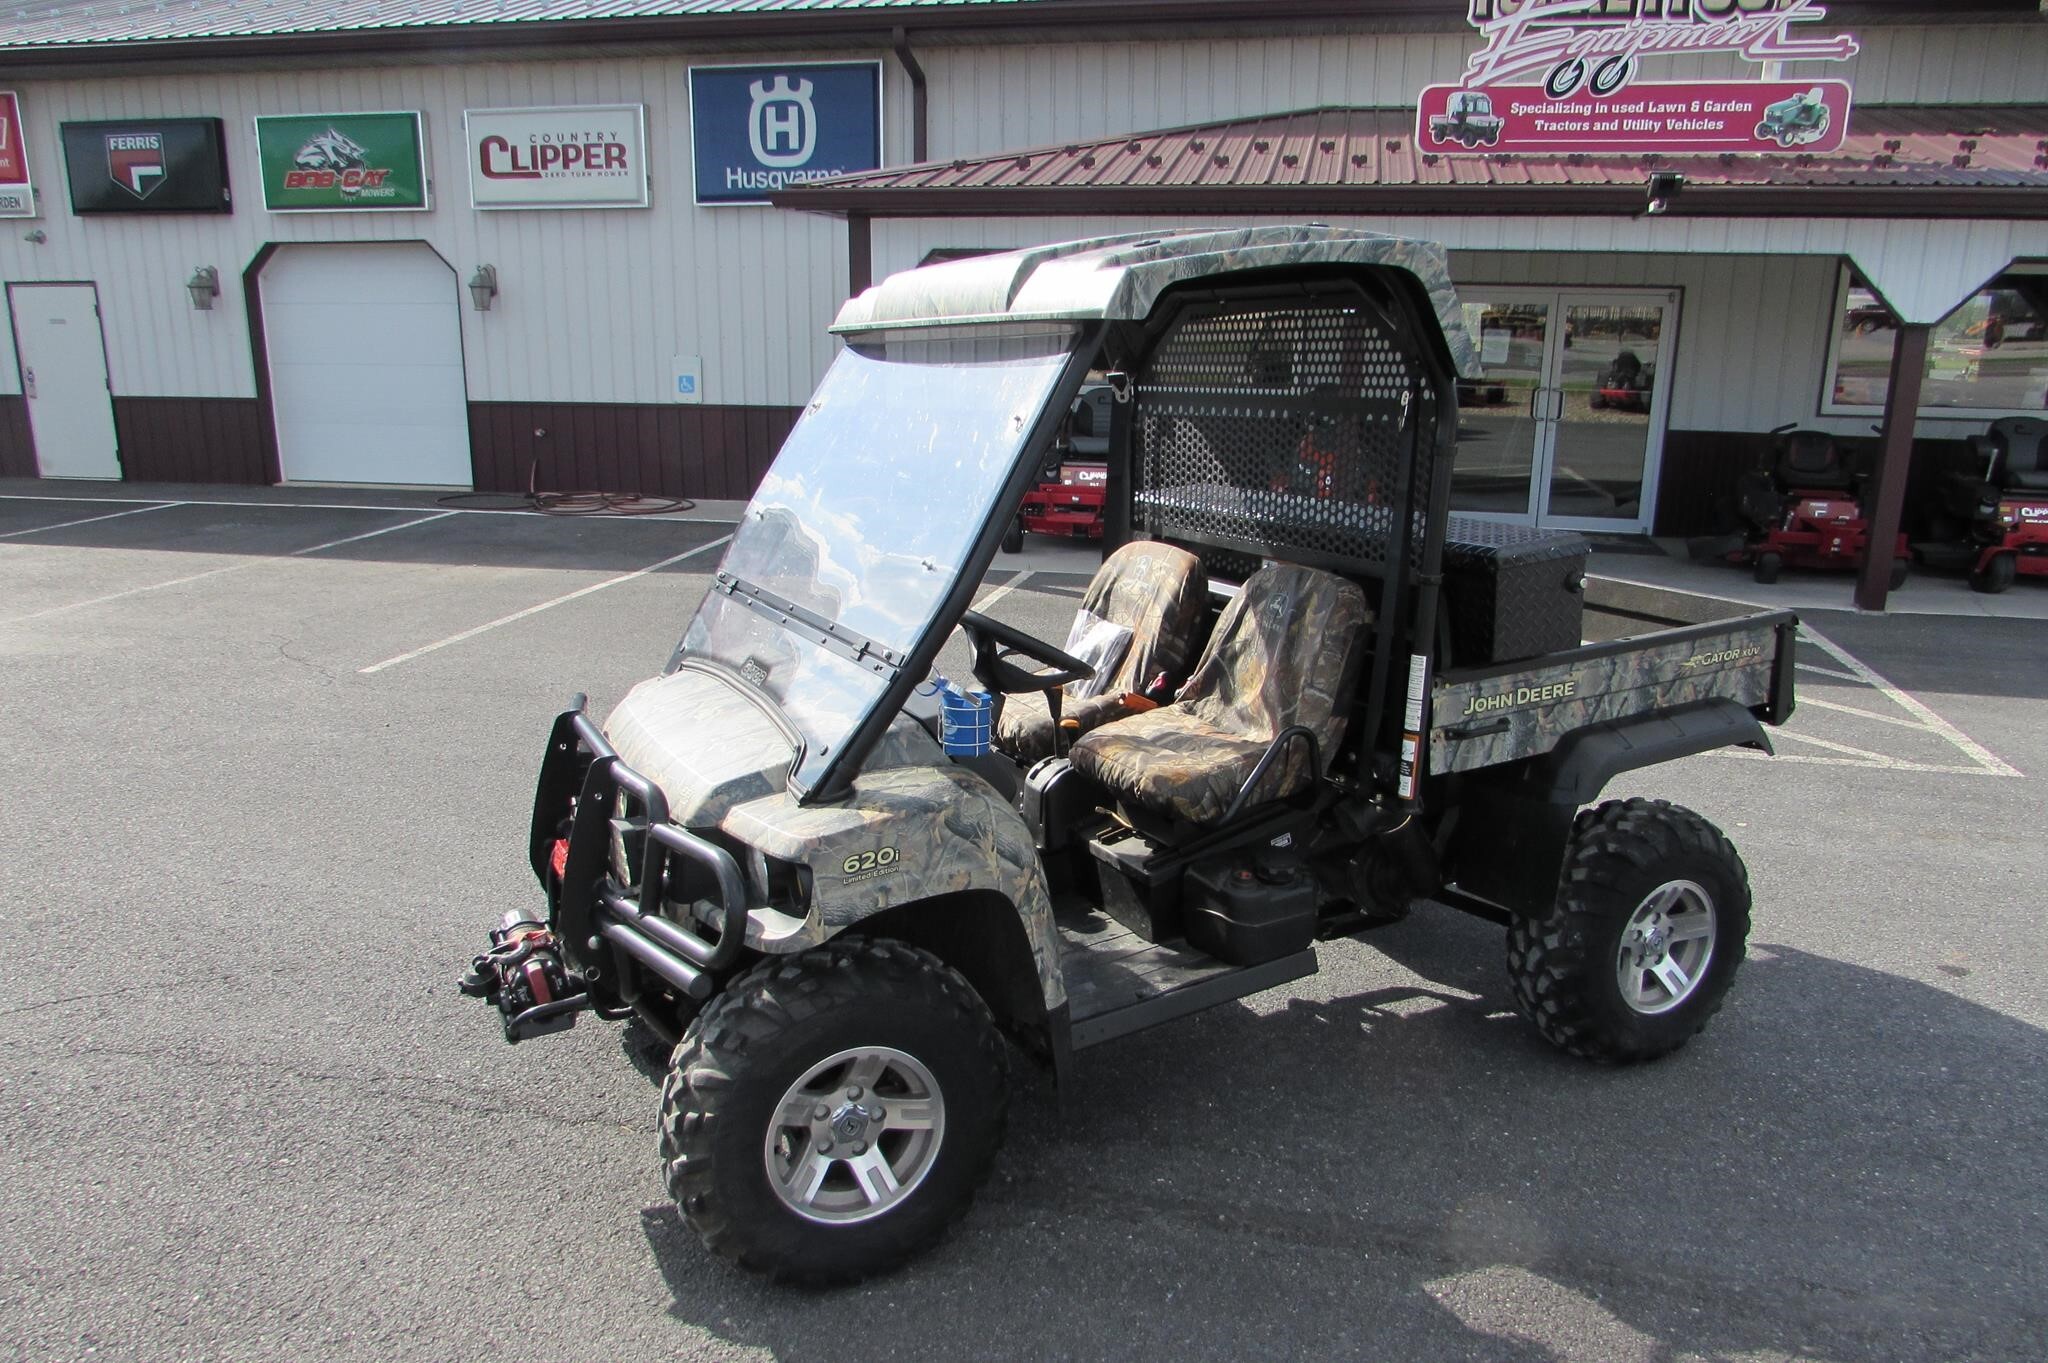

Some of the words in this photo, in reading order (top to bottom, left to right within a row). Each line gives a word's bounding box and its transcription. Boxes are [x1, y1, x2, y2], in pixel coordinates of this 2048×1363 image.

[1467, 0, 1846, 88] Equipment
[1510, 102, 1591, 116] Specializing
[1612, 102, 1644, 113] used
[1648, 101, 1686, 113] Lawn
[1690, 101, 1699, 112] &
[1703, 100, 1752, 112] Garden
[1535, 119, 1589, 131] Tractors
[1593, 118, 1618, 131] and
[1622, 118, 1661, 132] Utility
[1666, 118, 1724, 130] Vehicles
[110, 136, 160, 150] FERRIS
[529, 131, 618, 144] COUNTRY
[479, 135, 628, 179] CLIPPER
[360, 188, 395, 197] MOWERS
[1701, 648, 1740, 666] GATOR
[1463, 692, 1513, 716] JOHN
[1516, 681, 1575, 706] DEERE
[842, 847, 900, 874] 620i
[843, 872, 871, 885] Limited
[873, 865, 900, 876] Edition
